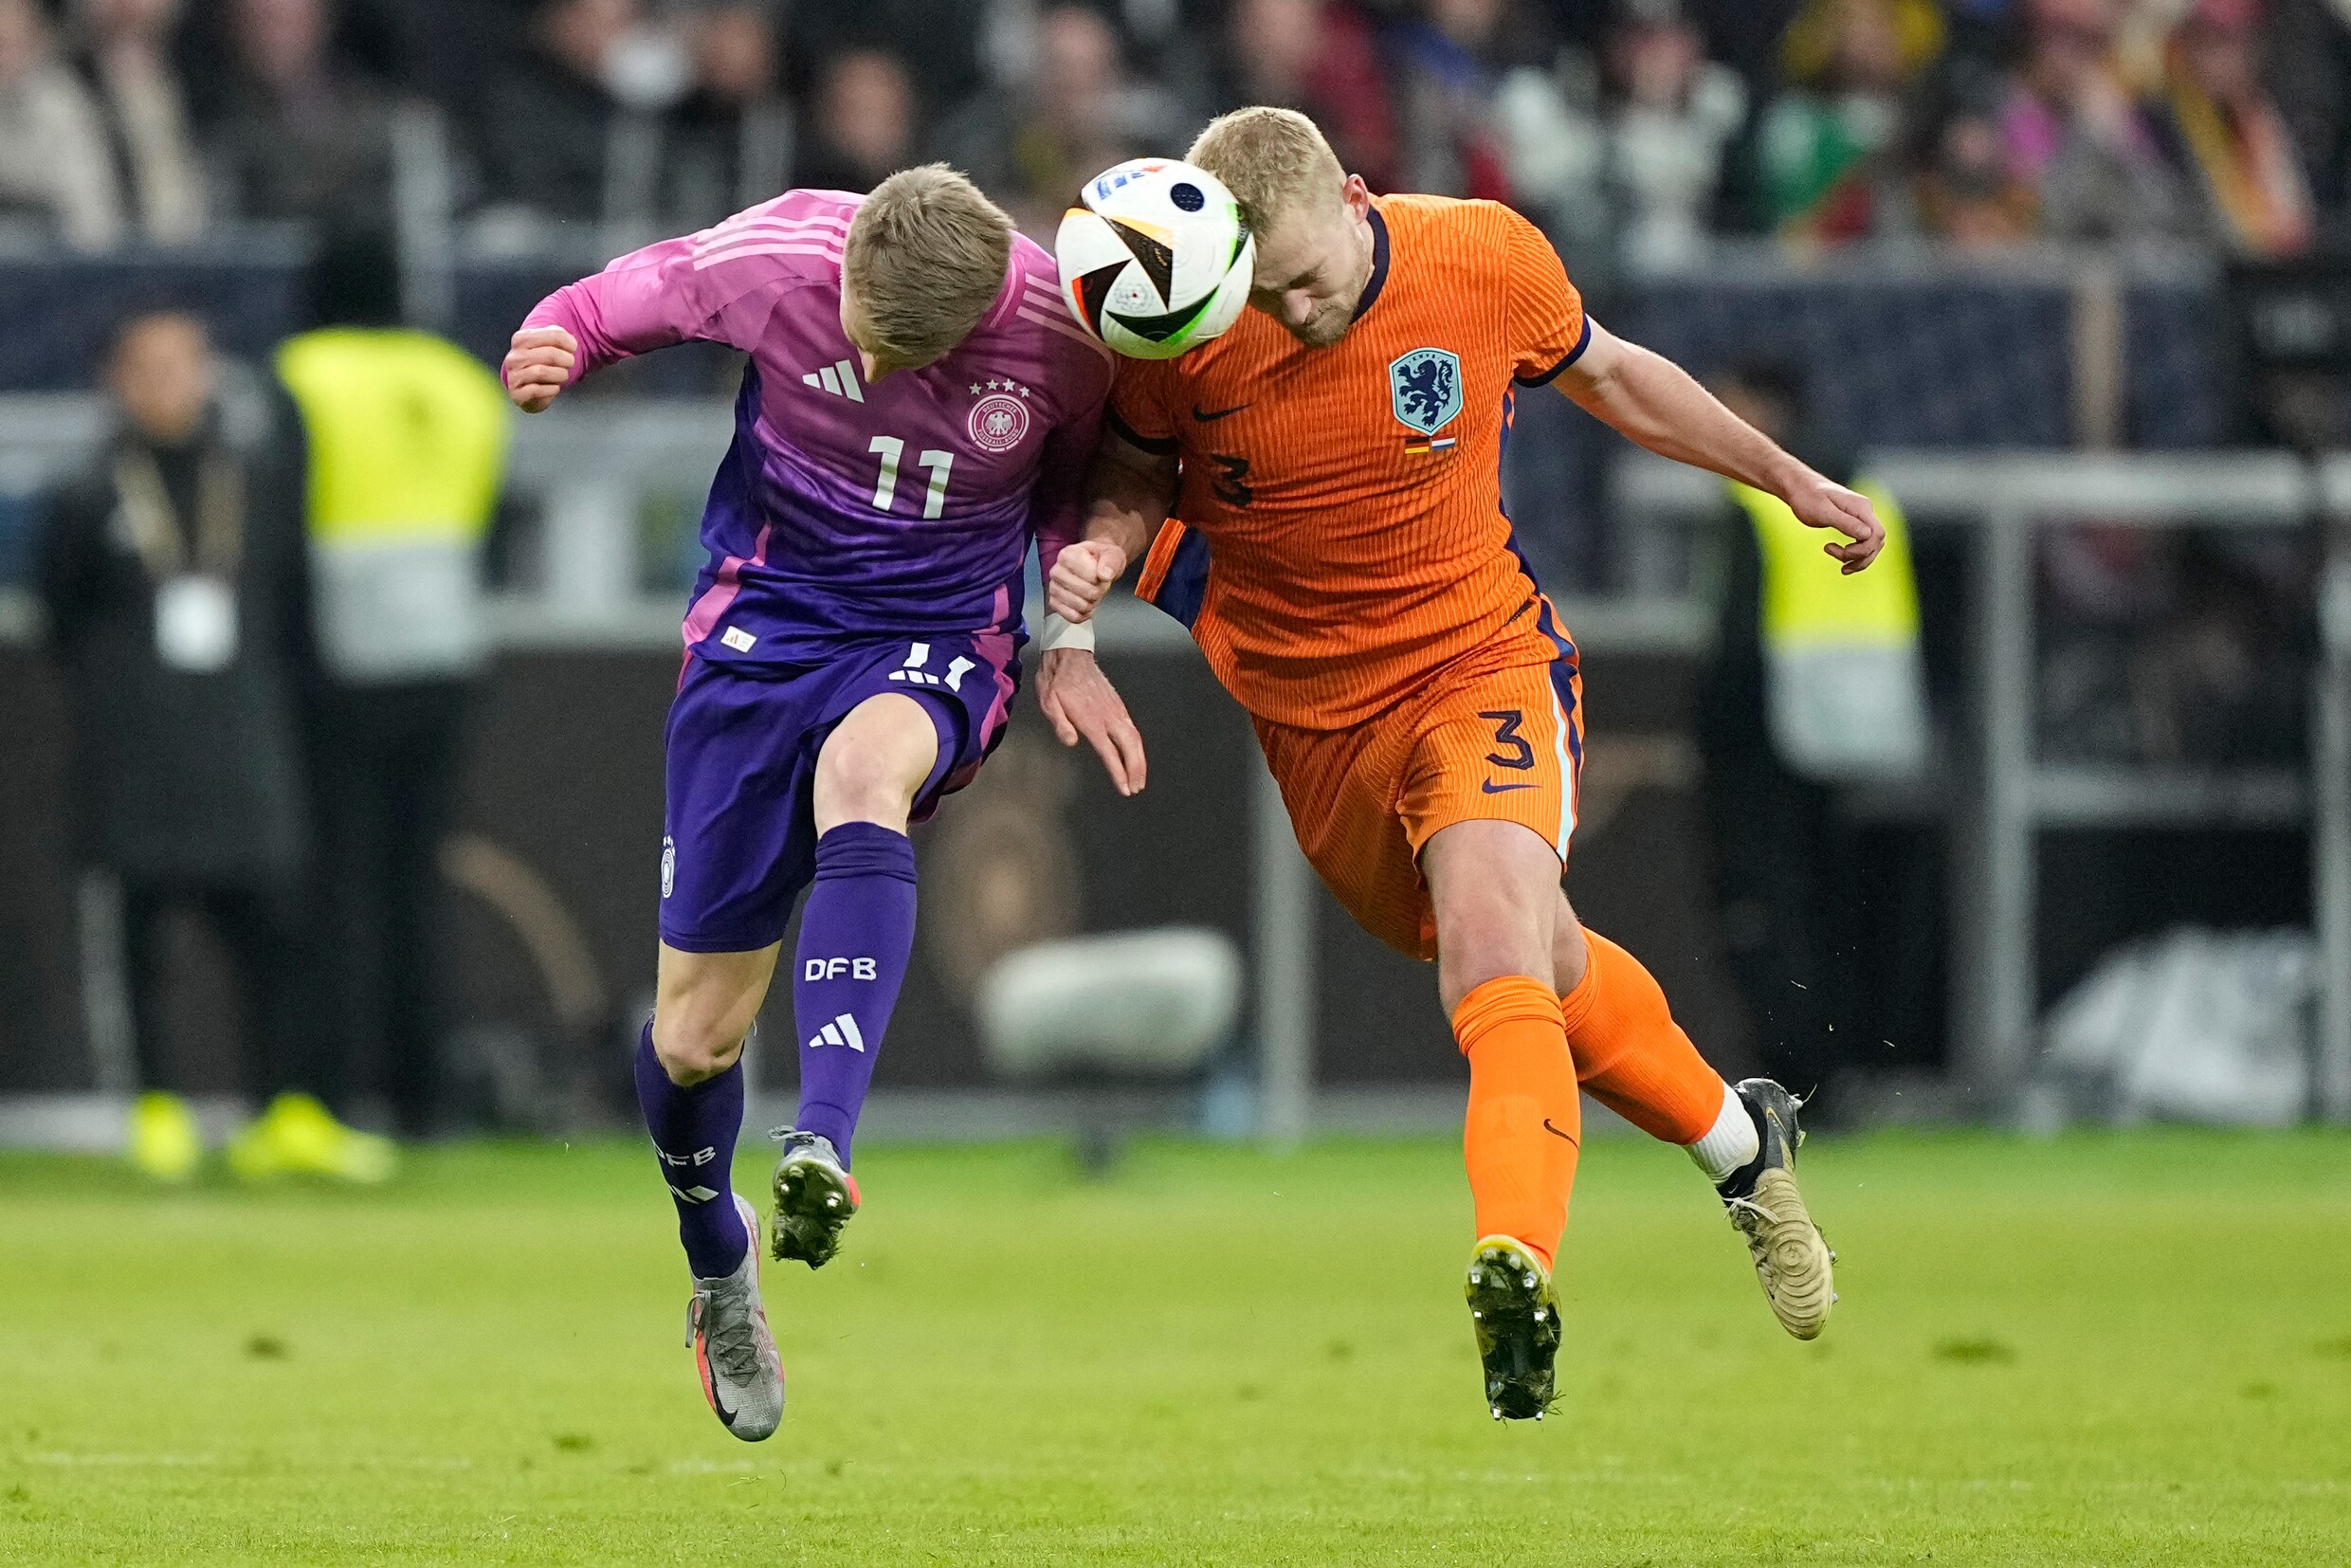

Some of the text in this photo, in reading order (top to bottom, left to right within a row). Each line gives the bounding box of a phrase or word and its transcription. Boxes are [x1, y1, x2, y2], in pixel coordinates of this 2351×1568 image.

[868, 435, 955, 520] 11
[1212, 453, 1252, 506] 3
[1478, 710, 1535, 770] 3
[805, 957, 877, 981] DFB
